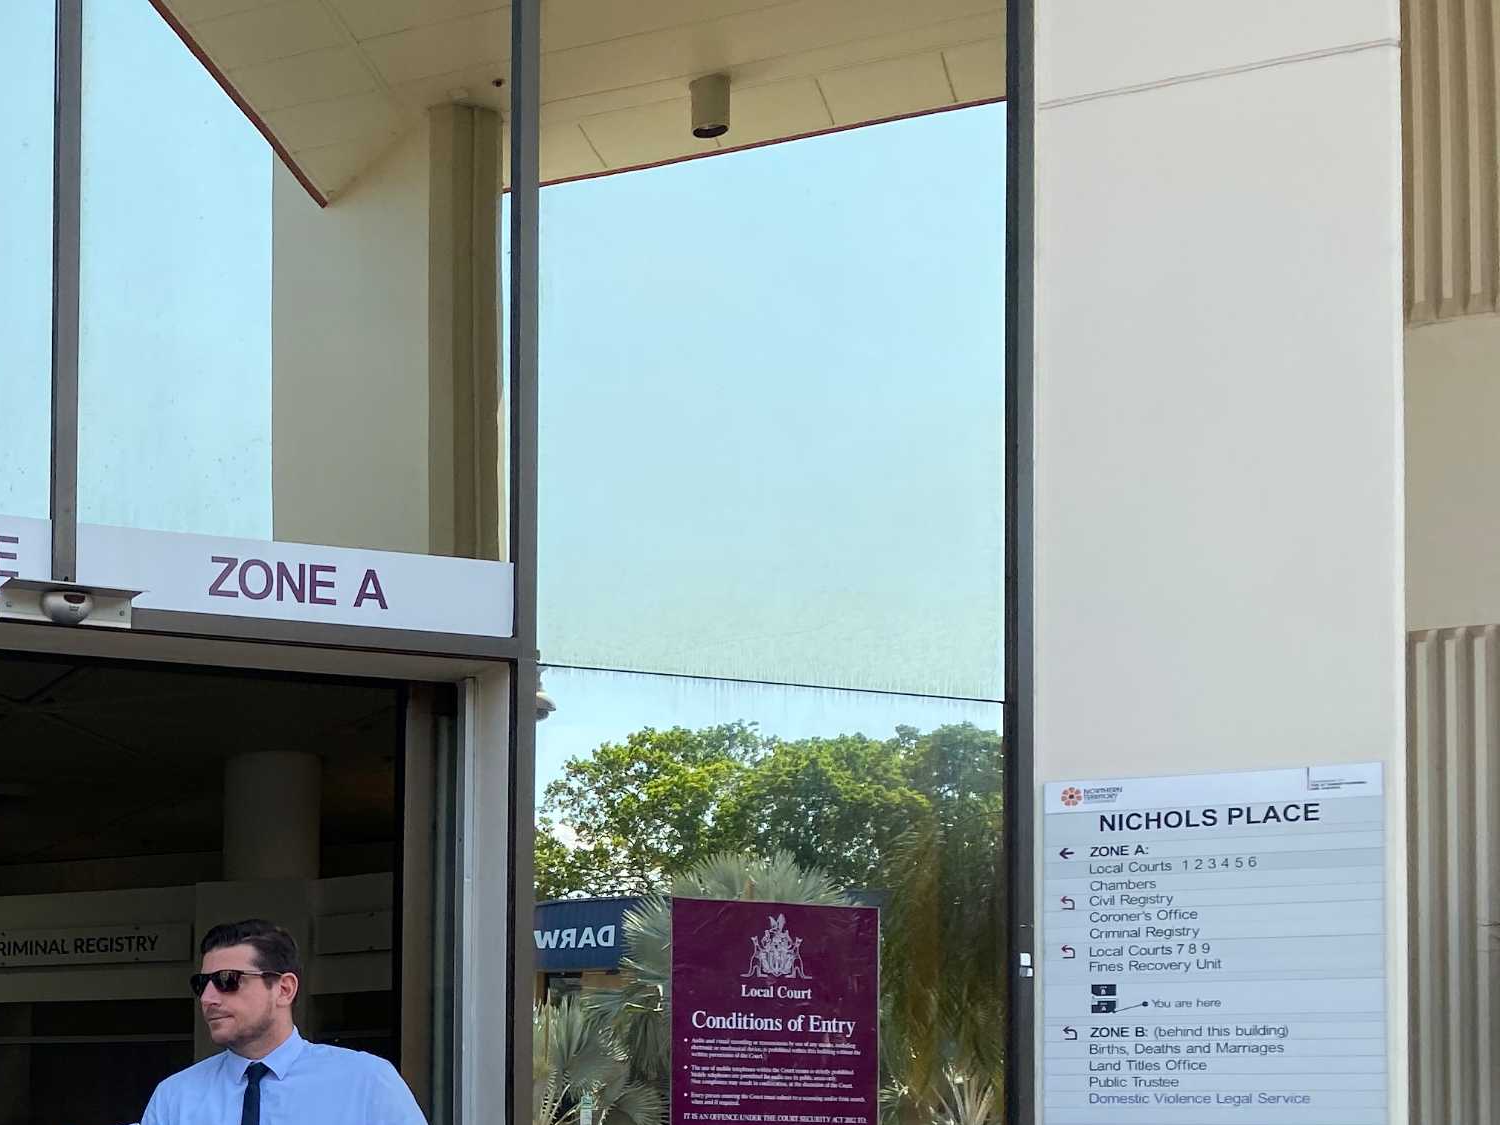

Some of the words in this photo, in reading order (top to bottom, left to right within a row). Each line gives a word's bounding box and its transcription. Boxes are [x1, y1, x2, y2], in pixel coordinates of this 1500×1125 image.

[208, 555, 336, 605] ZONE
[354, 568, 388, 610] A
[1100, 808, 1218, 832] NICHOLS
[1228, 803, 1320, 825] PLACE
[1090, 845, 1130, 857] ZONE
[1134, 845, 1149, 855] A:
[1089, 862, 1124, 874] Local
[1129, 860, 1172, 872] Courts
[1182, 861, 1188, 870] 1
[1194, 860, 1202, 870] 2
[1208, 859, 1217, 869] 3
[1221, 858, 1230, 868] 4
[1235, 857, 1244, 867] 5
[1248, 857, 1257, 867] 6
[1090, 878, 1156, 891] Chambers
[1089, 894, 1115, 906] Civil
[1120, 893, 1173, 907] Registry
[1089, 911, 1152, 923] Coroner's
[1157, 909, 1198, 921] Office
[1089, 927, 1141, 939] Criminal
[1146, 926, 1200, 940] Registry
[75, 935, 159, 953] REGISTRY
[1089, 945, 1123, 957] Local
[1129, 944, 1172, 956] Courts
[1177, 944, 1184, 955] 7
[1188, 944, 1197, 954] 8
[1202, 943, 1210, 954] 9
[1089, 961, 1123, 972] Fines
[1129, 960, 1191, 974] Recovery
[1197, 959, 1221, 970] Unit
[741, 985, 774, 998] Local
[777, 985, 812, 1000] Court
[1152, 999, 1171, 1008] You
[1175, 1000, 1192, 1008] are
[1197, 998, 1221, 1008] here
[692, 1011, 783, 1032] Conditions
[788, 1015, 807, 1032] of
[810, 1016, 855, 1037] Entry
[1090, 1027, 1130, 1038] ZONE
[1135, 1027, 1148, 1038] B:
[1154, 1026, 1202, 1039] (behind
[1207, 1026, 1230, 1037] this
[1235, 1024, 1289, 1039] building)
[1089, 1043, 1130, 1055] Births,
[1134, 1042, 1180, 1055] Deaths
[1186, 1042, 1210, 1054] and
[1216, 1042, 1284, 1056] Marriages
[1089, 1060, 1121, 1071] Land
[1126, 1059, 1160, 1071] Titles
[1165, 1059, 1207, 1071] Office
[1089, 1077, 1128, 1088] Public
[1132, 1077, 1179, 1088] Trustee
[1089, 1093, 1149, 1104] Domestic
[1154, 1093, 1211, 1104] Violence
[1216, 1093, 1252, 1106] Legal
[1258, 1093, 1310, 1104] Service
